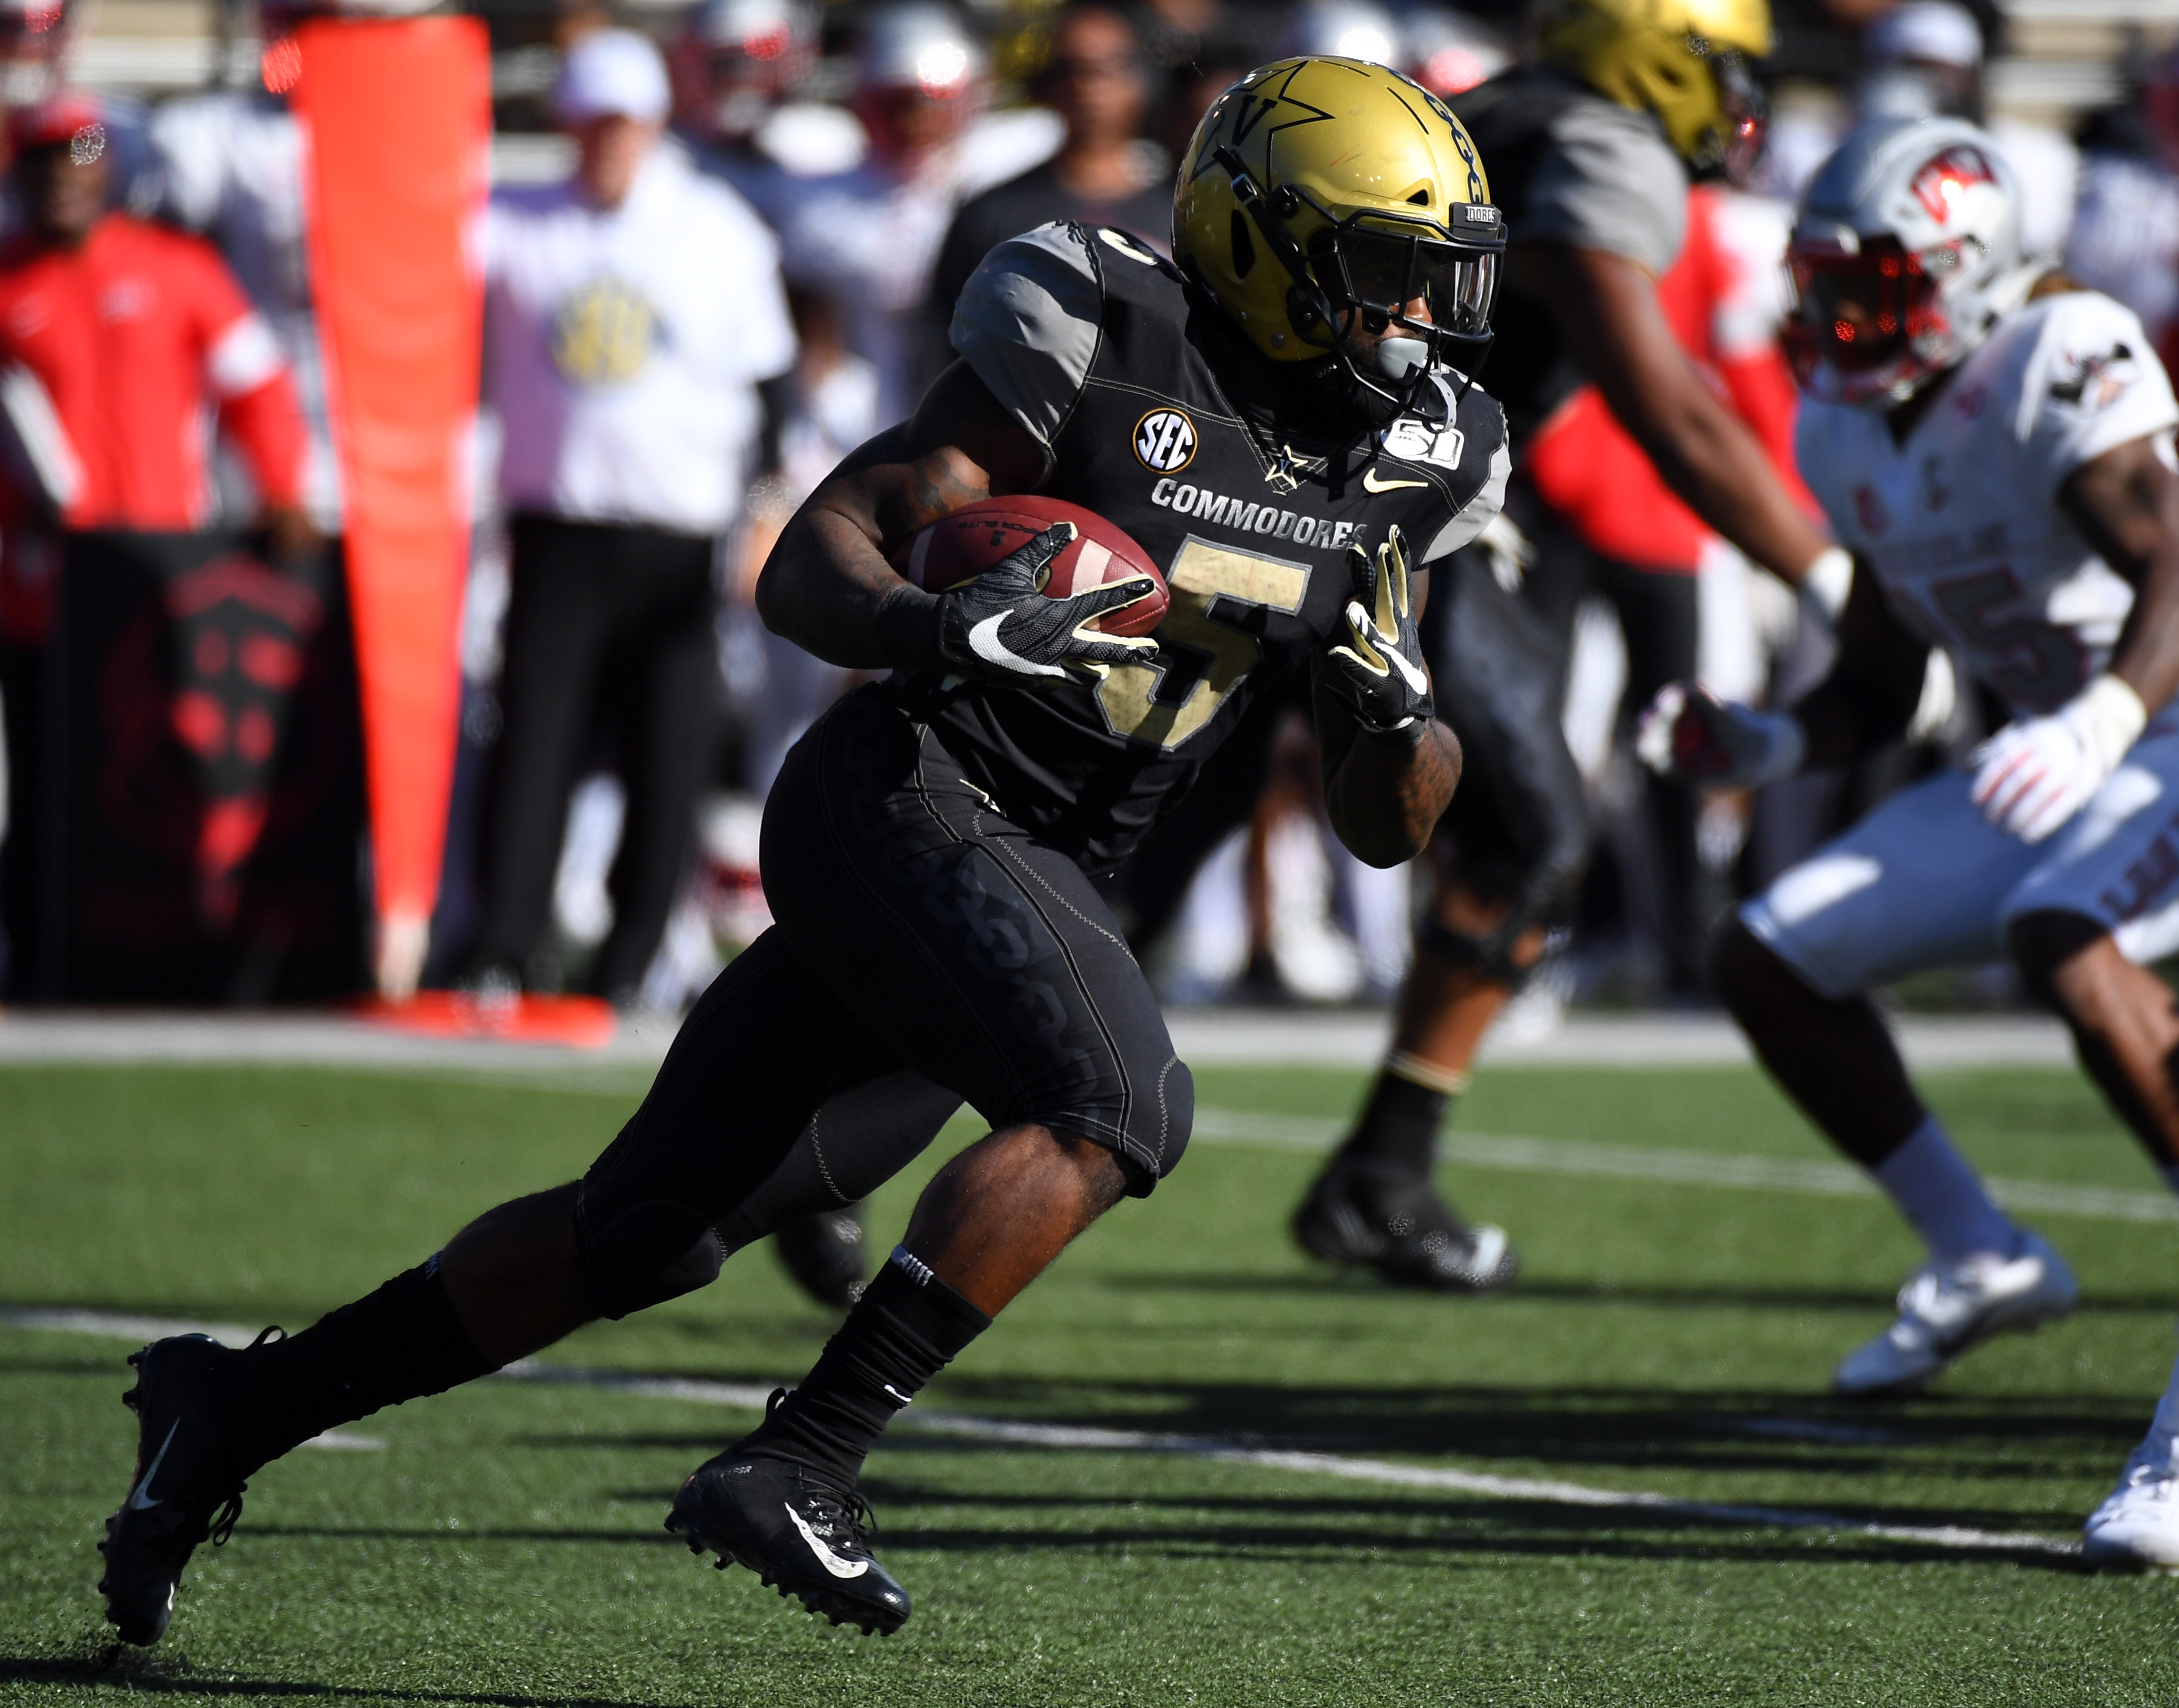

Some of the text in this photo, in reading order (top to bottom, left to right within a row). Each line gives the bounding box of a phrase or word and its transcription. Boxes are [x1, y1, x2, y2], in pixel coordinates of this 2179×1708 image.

[1231, 95, 1278, 147] V
[1469, 208, 1496, 222] DORES
[1138, 413, 1193, 470] SEC
[1280, 458, 1291, 474] V
[1151, 477, 1368, 551] COMMODORES
[1094, 533, 1313, 753] 5
